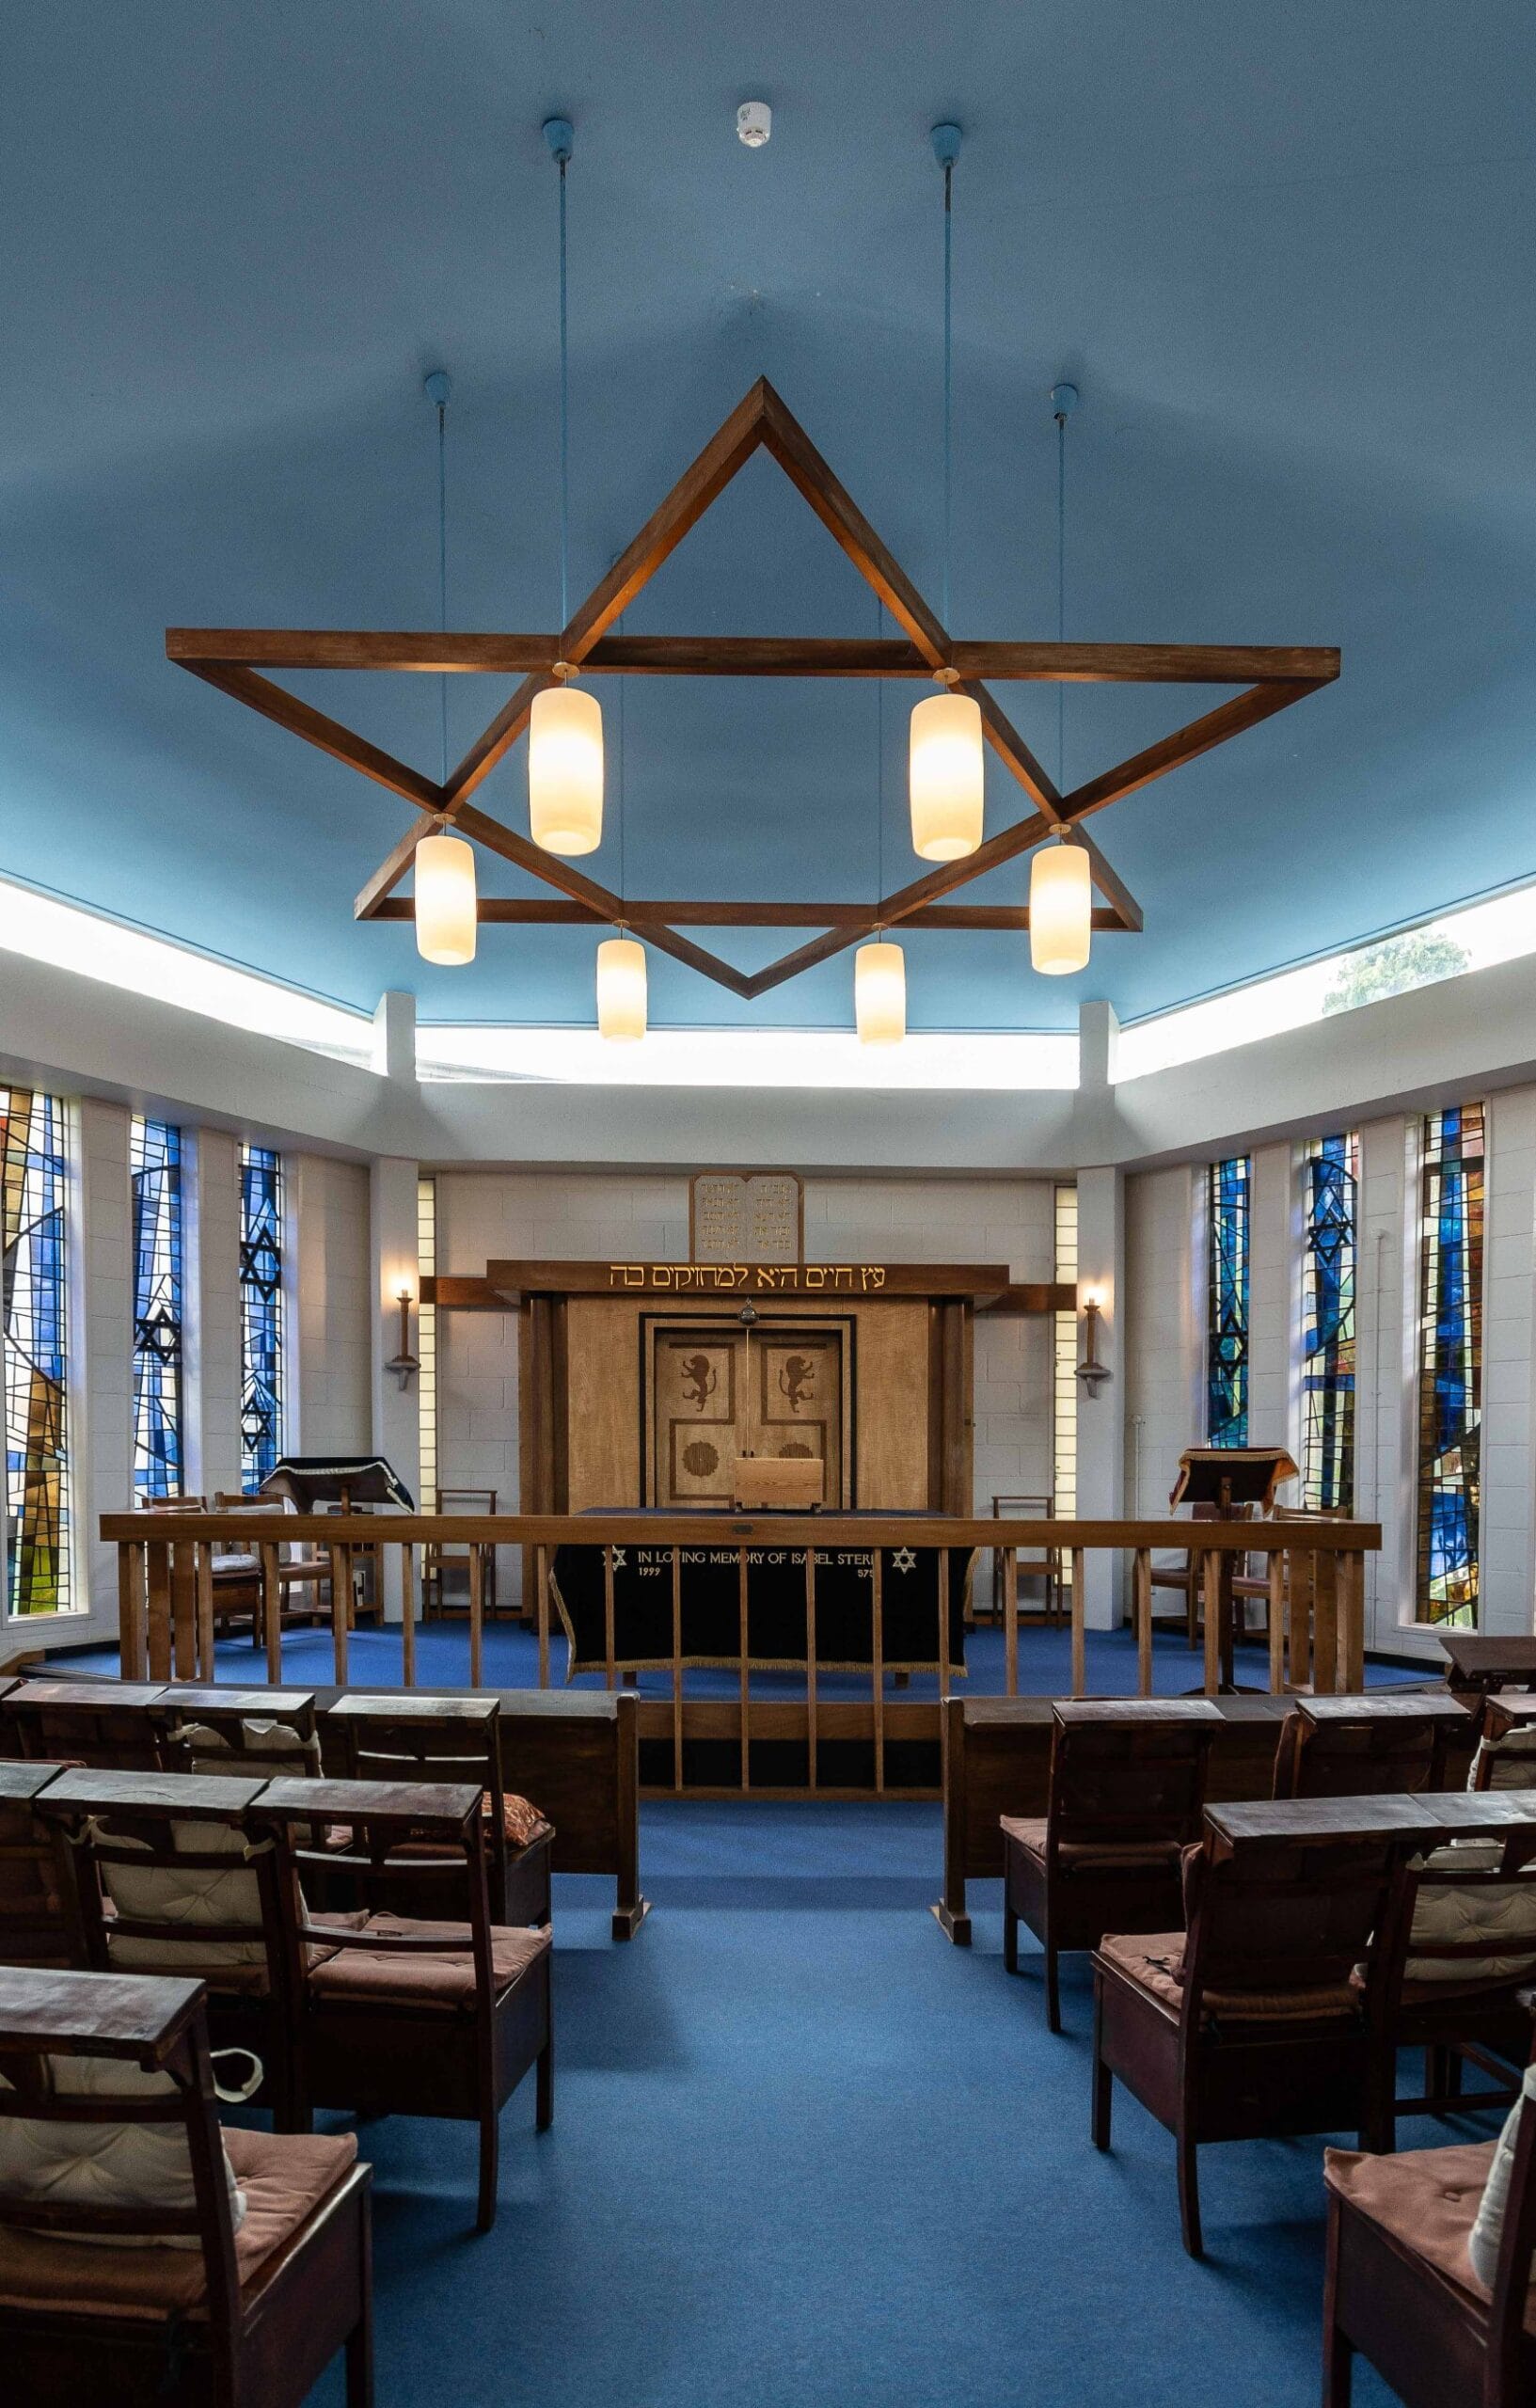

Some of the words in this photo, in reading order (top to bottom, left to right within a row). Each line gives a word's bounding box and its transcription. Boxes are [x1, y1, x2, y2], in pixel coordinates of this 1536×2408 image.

[652, 1262, 749, 1291] למחזיקים
[757, 1267, 798, 1287] היא
[806, 1267, 852, 1287] חיים
[861, 1267, 885, 1291] עץ
[638, 1551, 652, 1563] IN
[656, 1551, 706, 1563] LOING
[768, 1552, 787, 1564] OF
[639, 1567, 660, 1576] 1999
